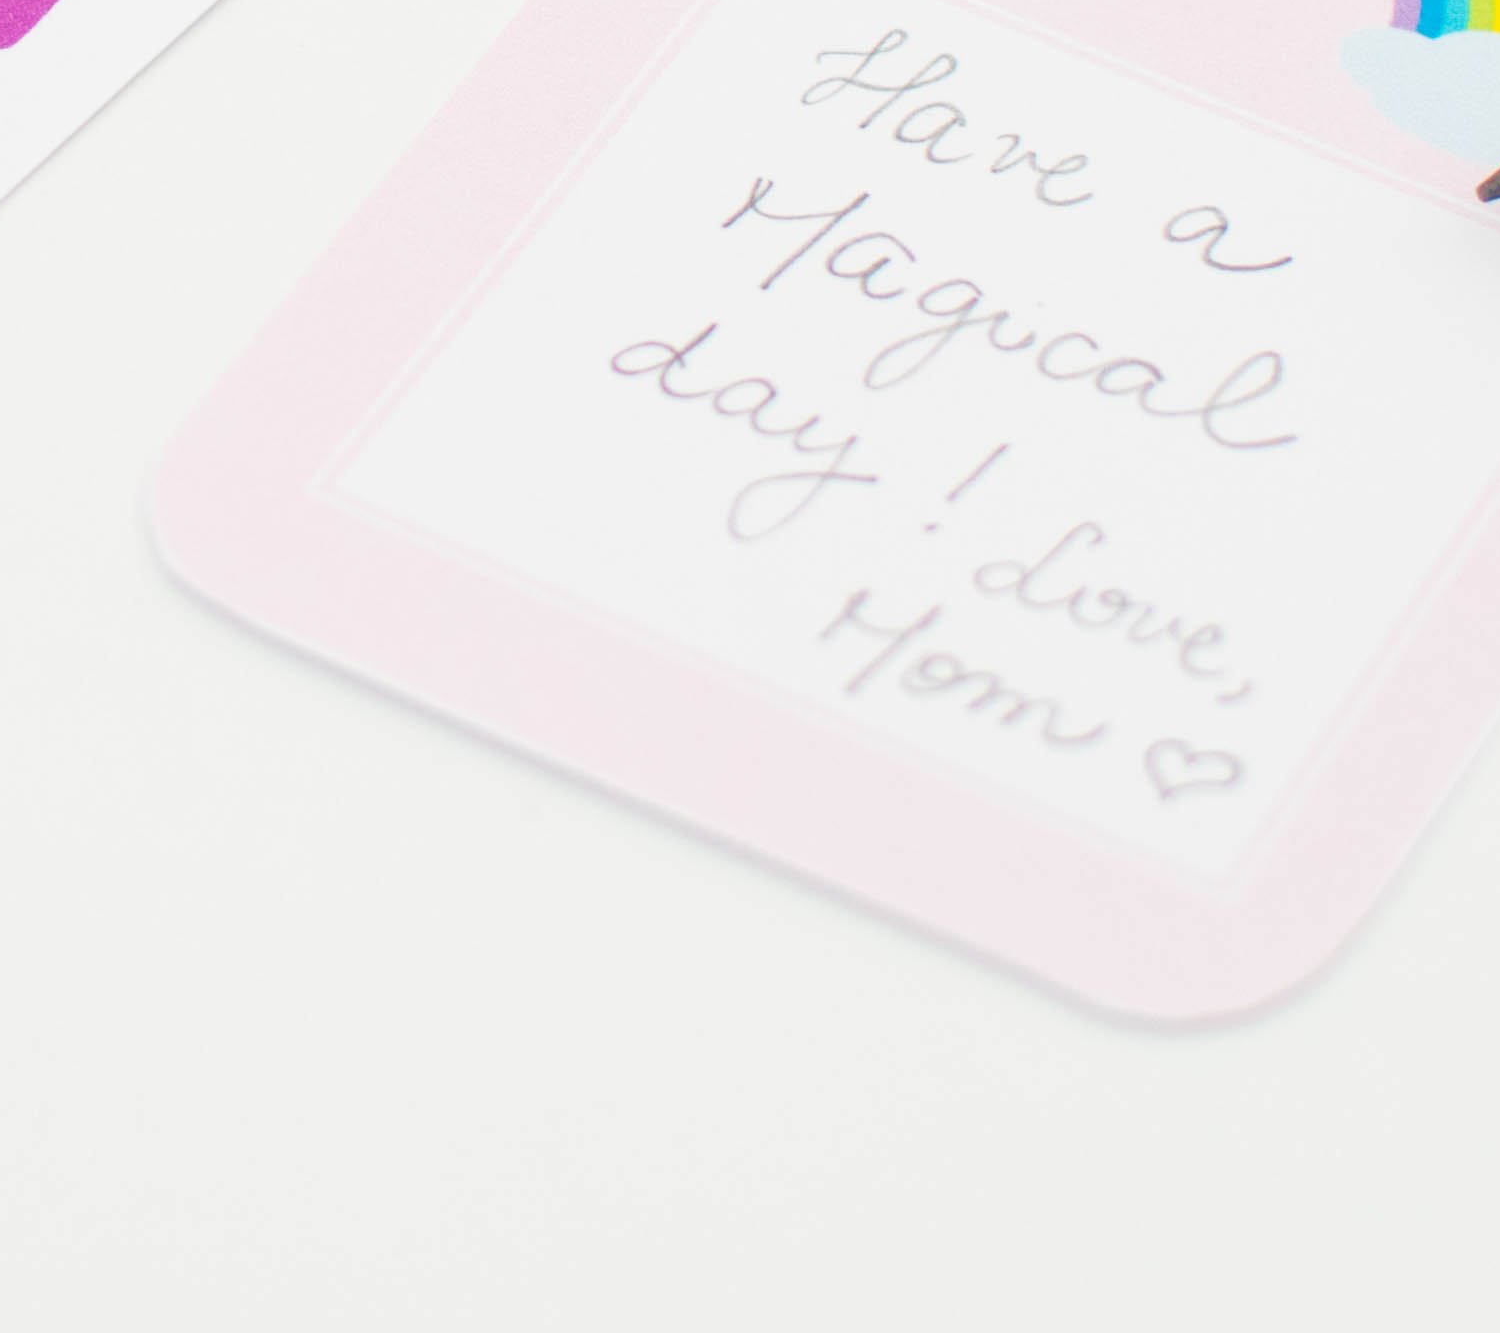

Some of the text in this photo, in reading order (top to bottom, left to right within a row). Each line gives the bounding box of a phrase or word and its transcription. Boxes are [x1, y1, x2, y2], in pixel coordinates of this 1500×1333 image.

[799, 27, 1296, 275] Have a
[718, 175, 1300, 453] Magical
[817, 585, 1109, 749] Mom
[972, 519, 1257, 708] Love,
